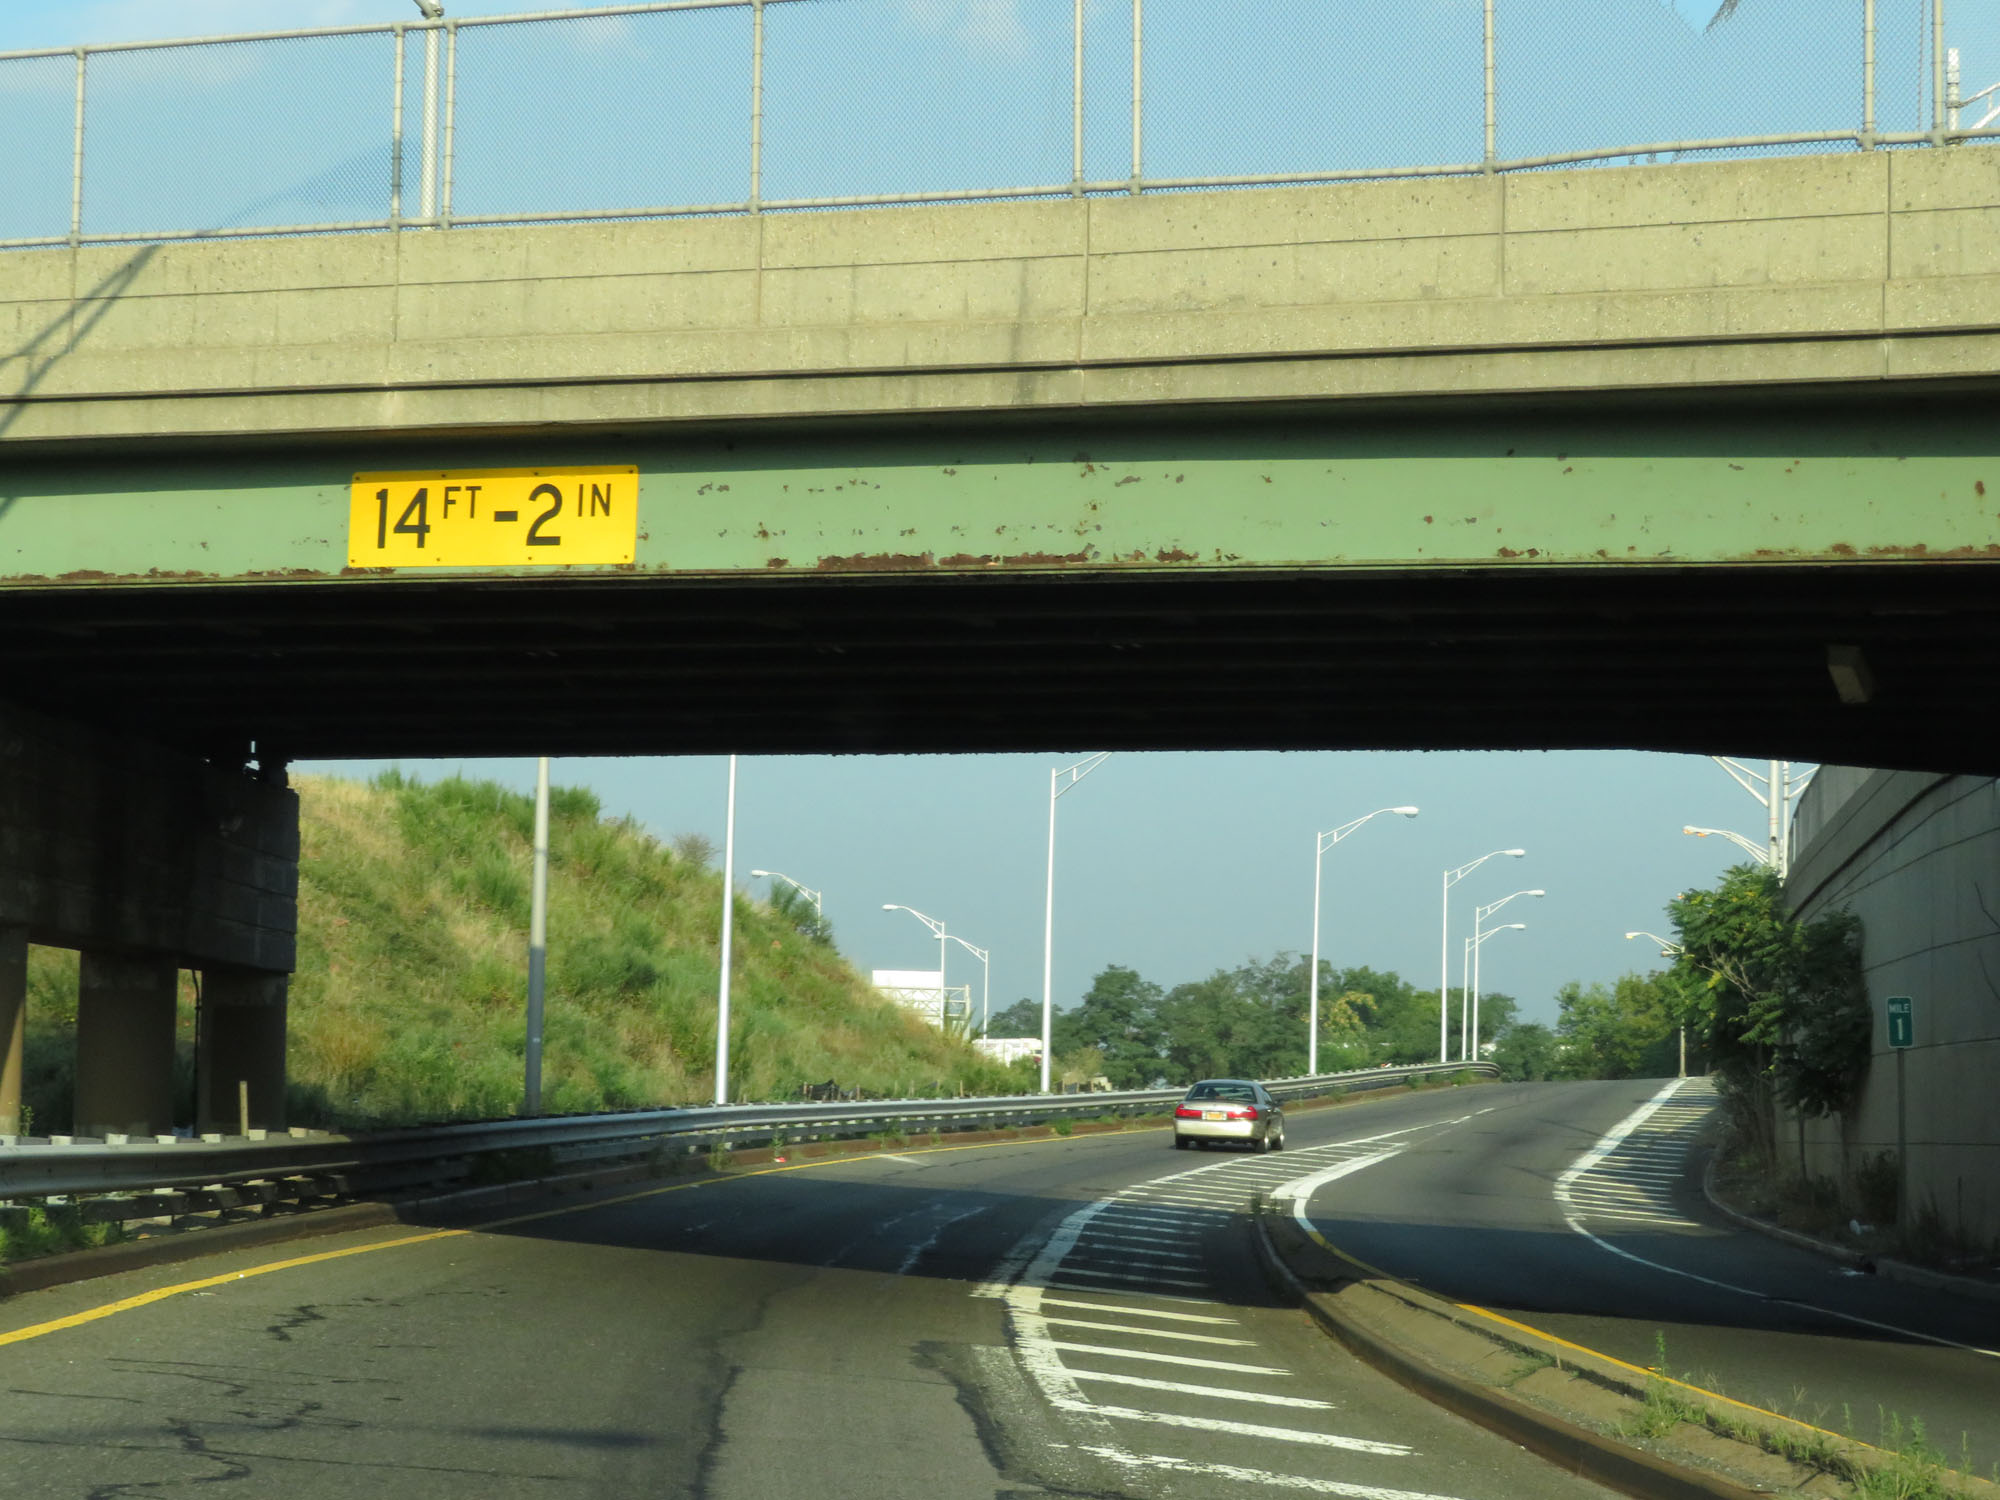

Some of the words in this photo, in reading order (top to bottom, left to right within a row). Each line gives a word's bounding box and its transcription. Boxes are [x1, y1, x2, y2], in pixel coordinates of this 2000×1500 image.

[376, 488, 430, 549] 14
[444, 486, 482, 519] FT
[578, 483, 611, 517] IN
[1889, 1003, 1910, 1013] MILE
[1896, 1018, 1903, 1040] 1
